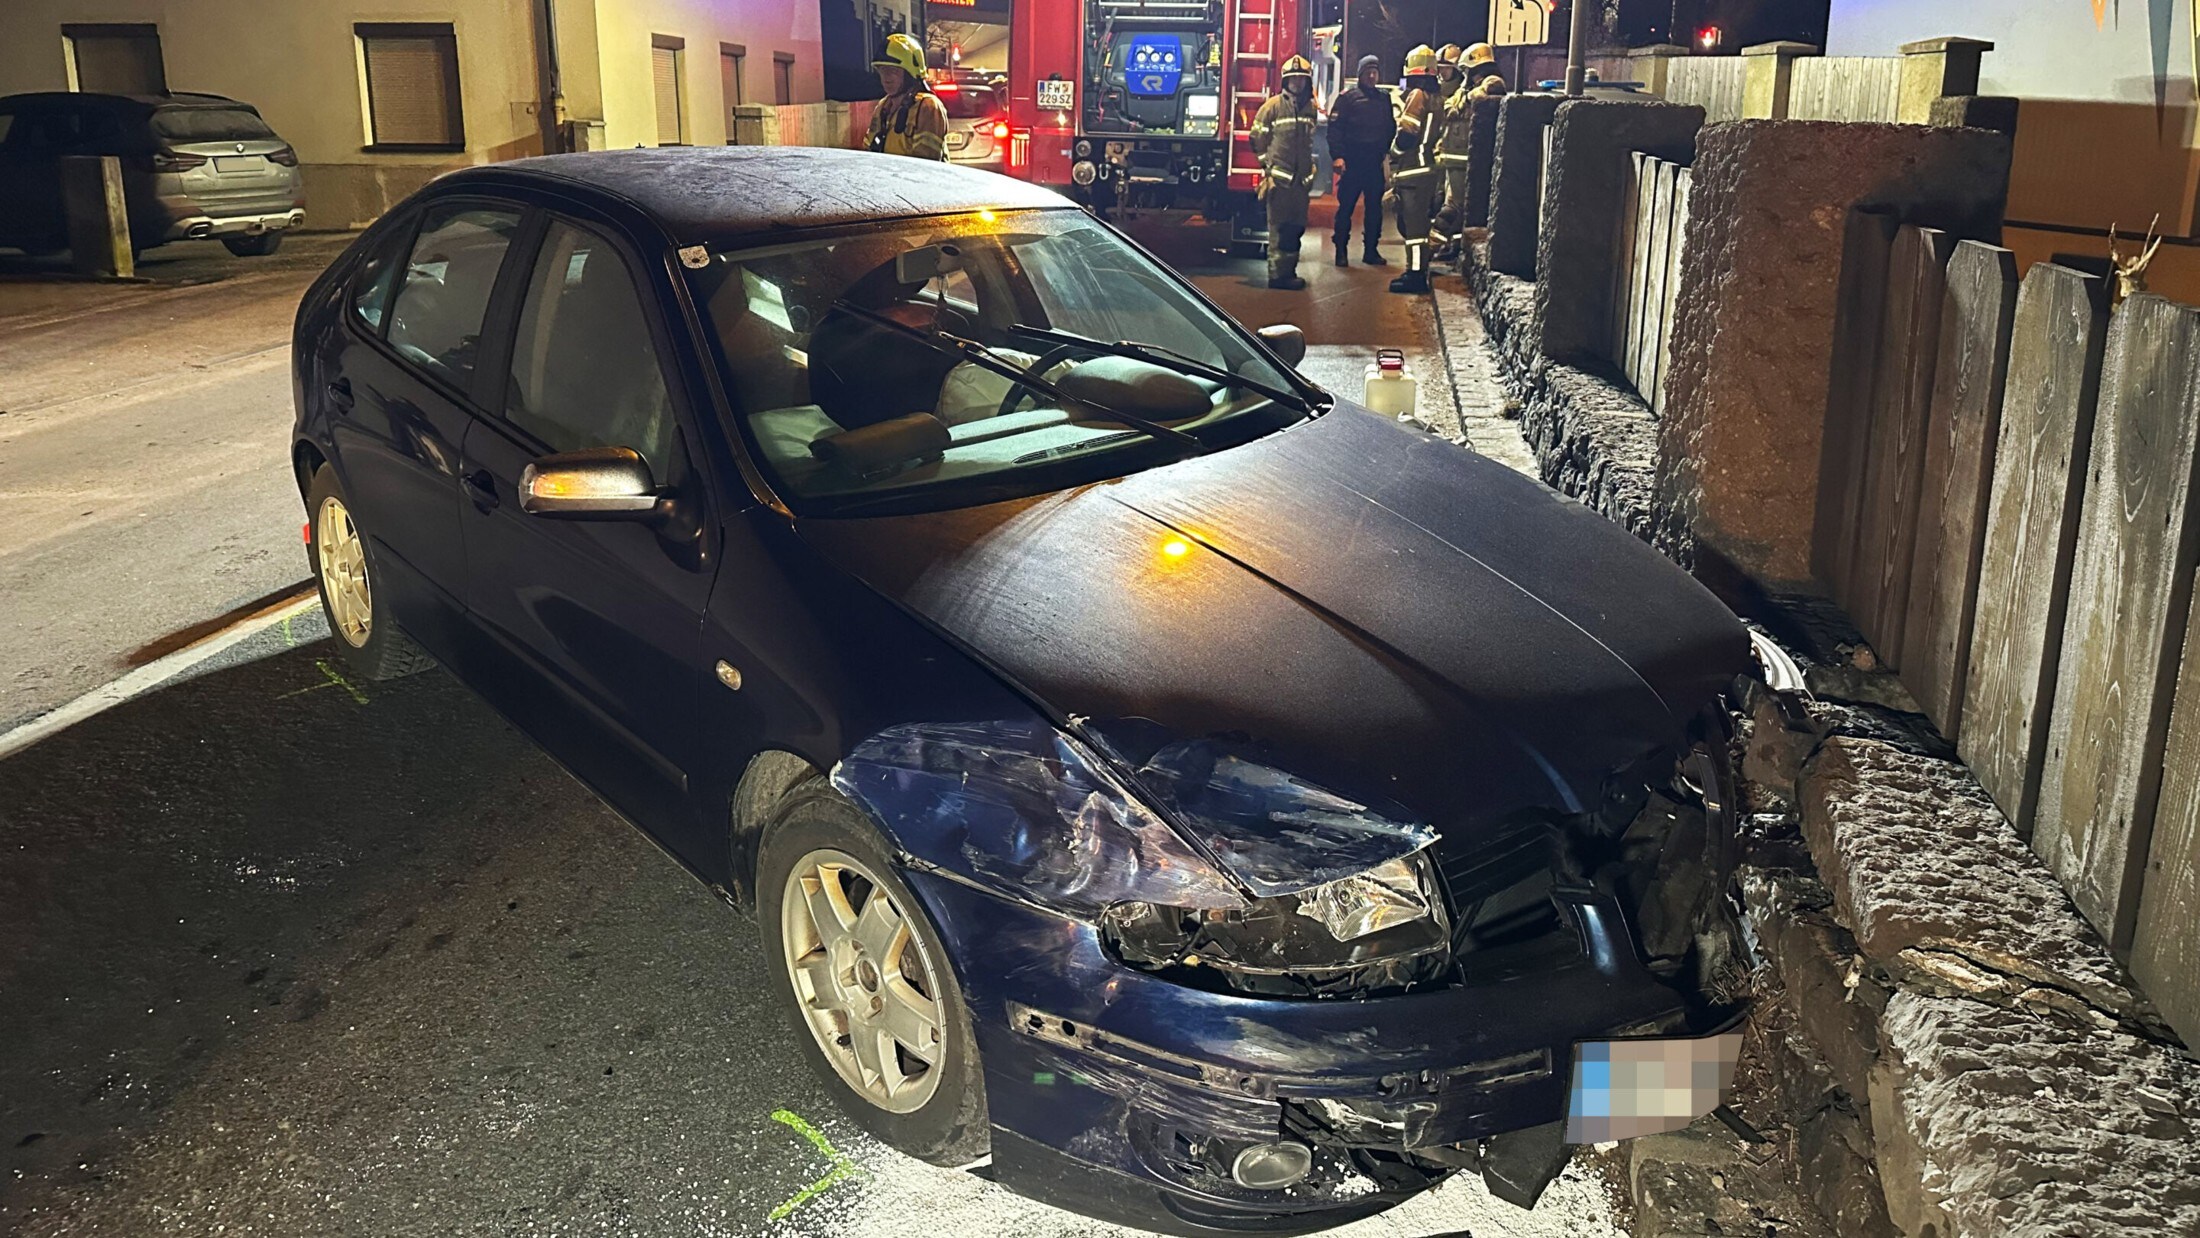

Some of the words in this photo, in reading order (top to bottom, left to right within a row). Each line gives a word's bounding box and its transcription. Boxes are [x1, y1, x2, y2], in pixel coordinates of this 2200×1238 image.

[1047, 83, 1061, 93] FW
[1040, 93, 1058, 104] 229
[1059, 94, 1071, 104] SZ
